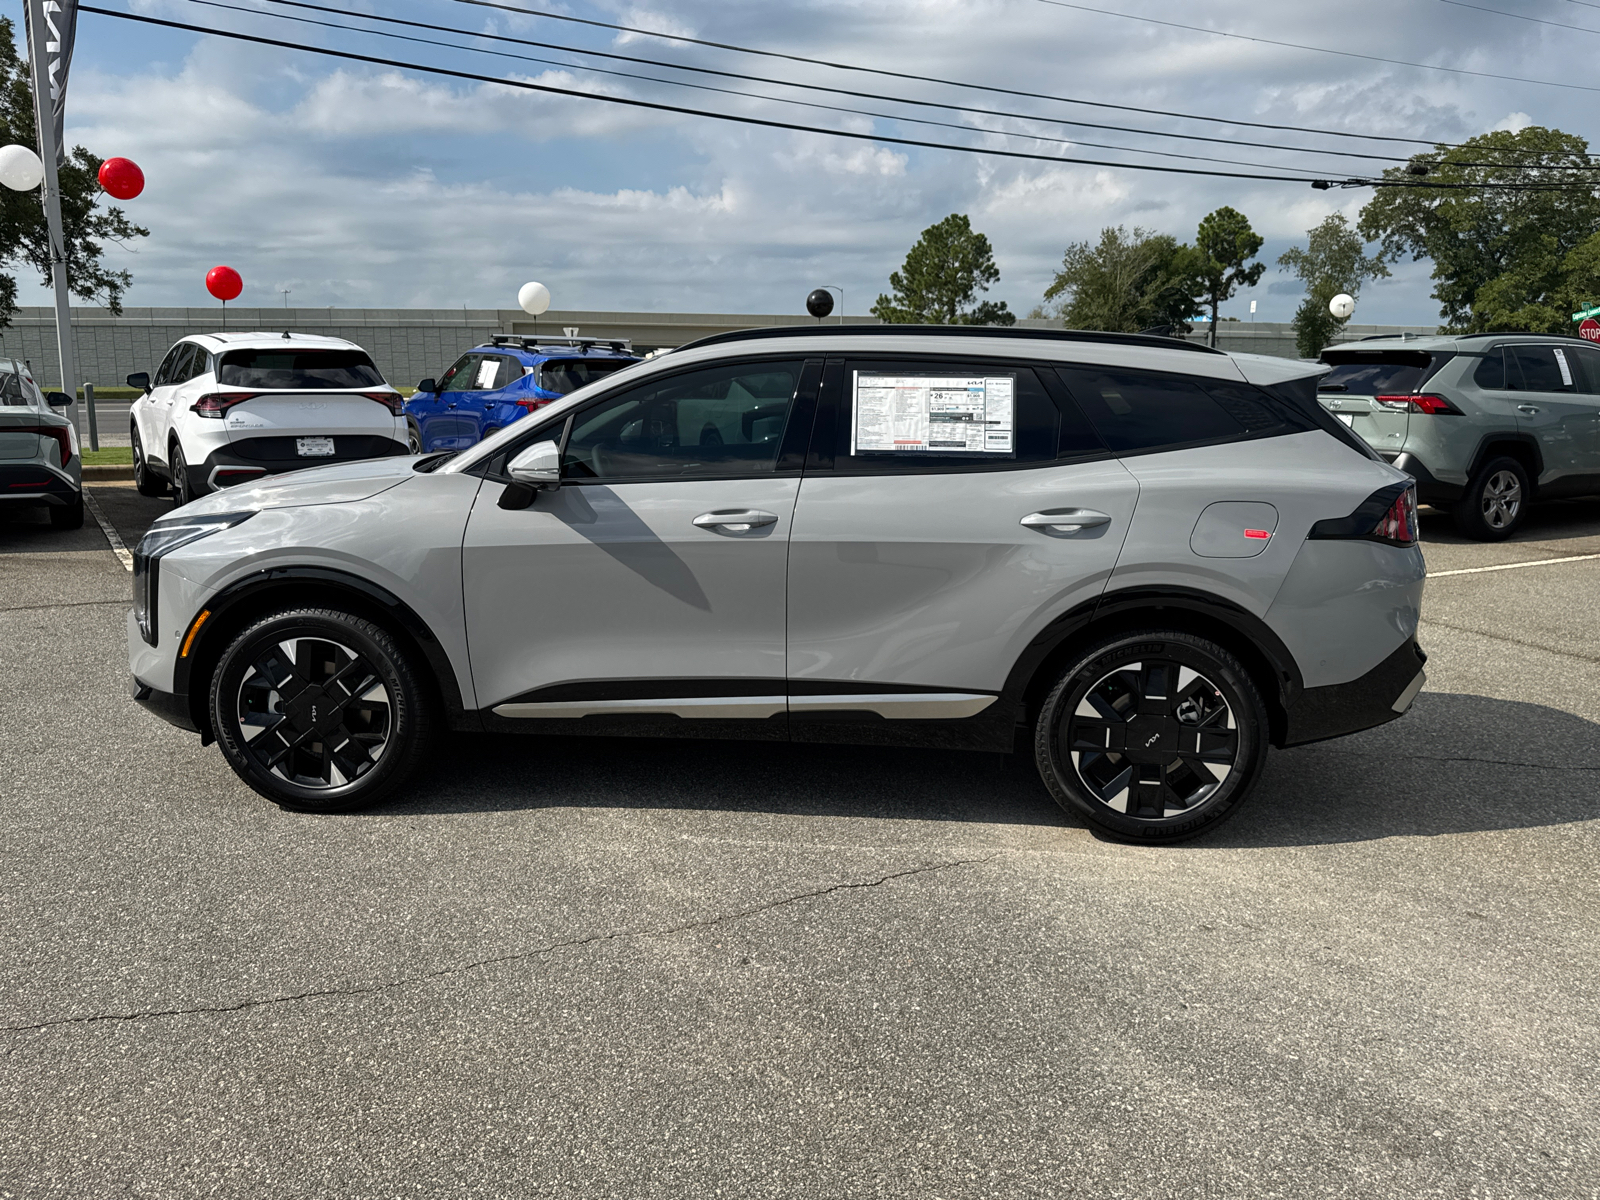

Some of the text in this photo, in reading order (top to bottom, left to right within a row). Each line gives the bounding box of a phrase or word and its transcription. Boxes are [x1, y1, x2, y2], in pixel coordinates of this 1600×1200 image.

[1581, 328, 1600, 340] STOP
[1101, 644, 1162, 666] MICHELIN
[390, 678, 406, 732] MICHELIN
